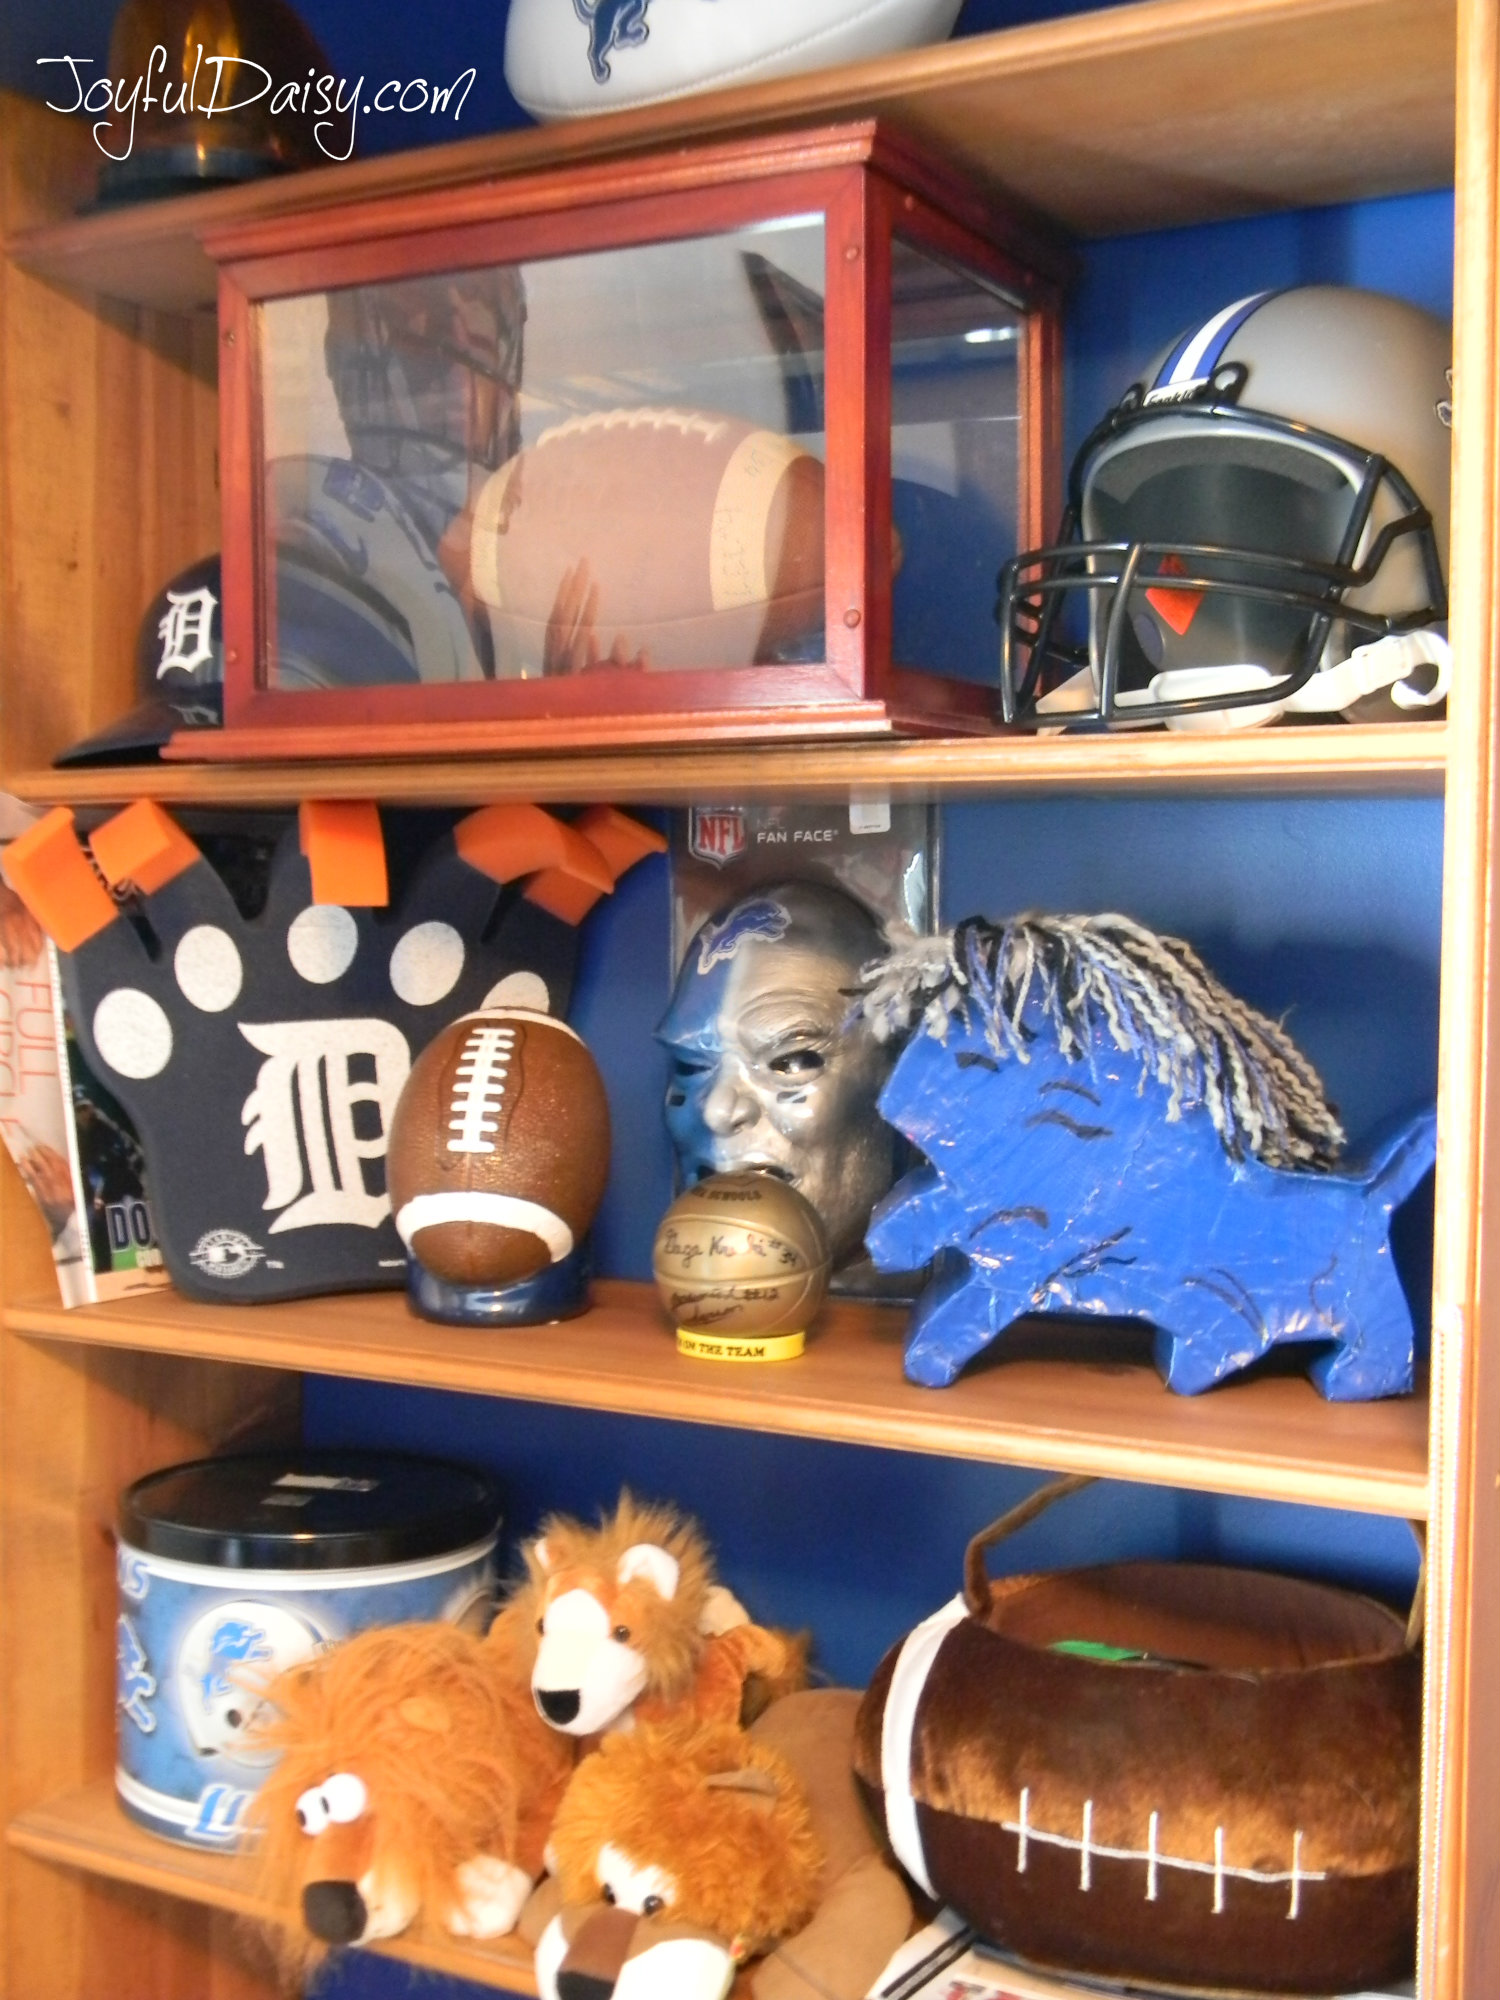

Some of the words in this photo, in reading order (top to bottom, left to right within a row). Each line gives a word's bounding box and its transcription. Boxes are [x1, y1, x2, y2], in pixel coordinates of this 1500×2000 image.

[156, 585, 218, 680] D
[699, 815, 746, 855] NFL
[756, 831, 788, 843] FAN
[15, 981, 57, 1095] FULL
[237, 1018, 410, 1234] D
[698, 1343, 723, 1355] THE
[726, 1345, 766, 1357] TEAM
